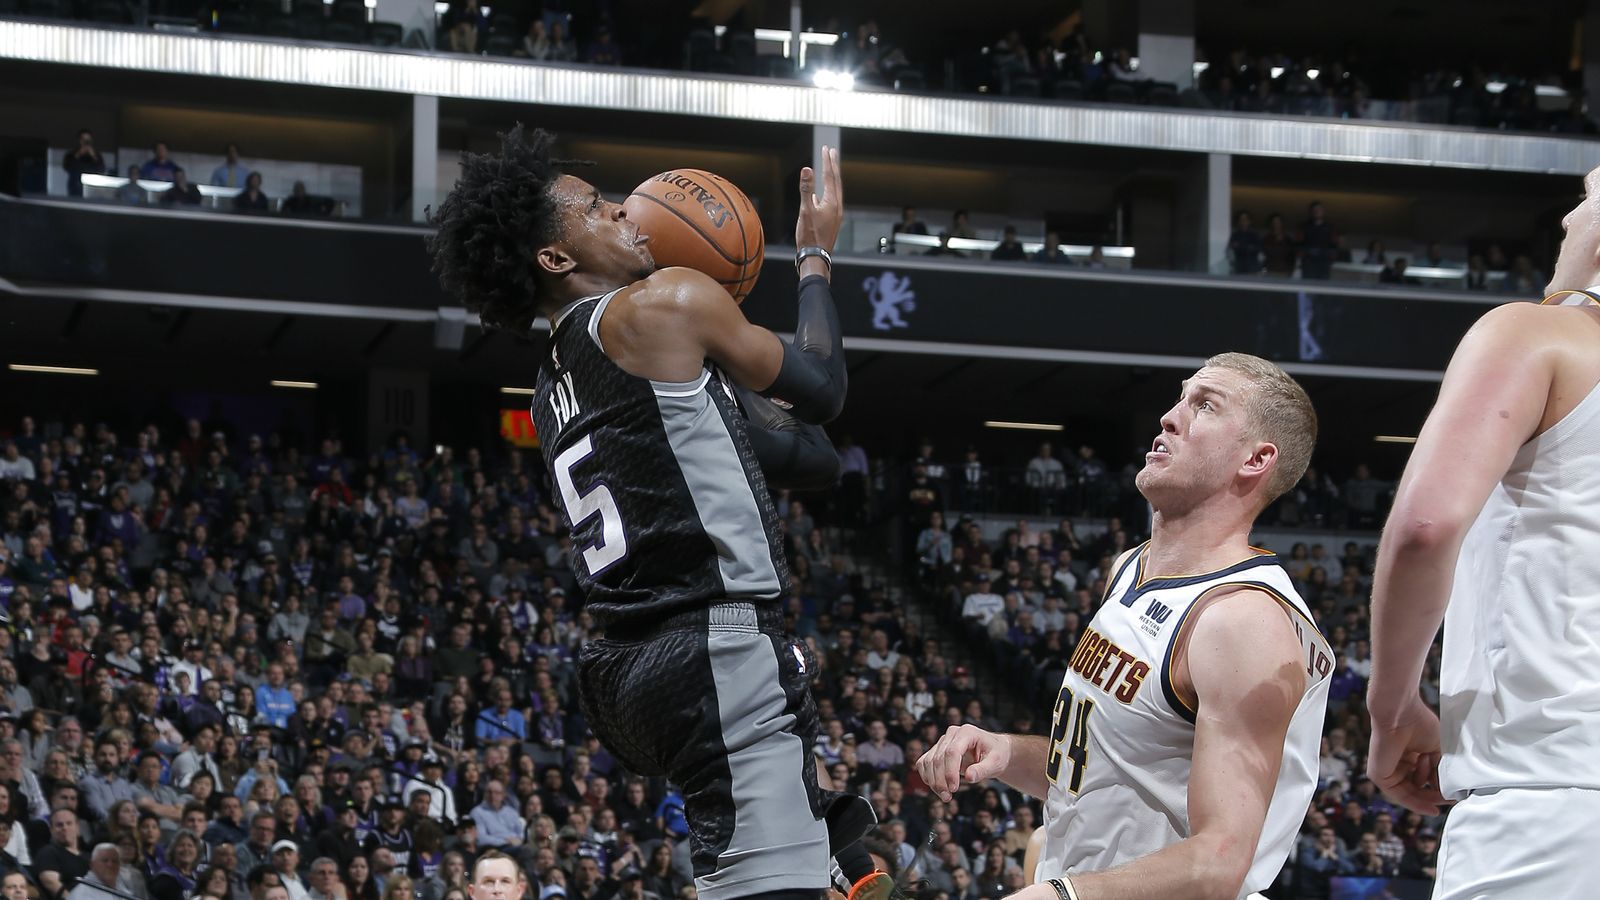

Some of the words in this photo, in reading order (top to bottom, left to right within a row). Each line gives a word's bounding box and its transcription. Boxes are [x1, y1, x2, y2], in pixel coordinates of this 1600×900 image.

[655, 171, 734, 229] SPALDIN
[549, 371, 581, 433] FOX
[553, 433, 628, 577] 5
[1140, 624, 1158, 637] UNION
[1145, 598, 1173, 624] WU
[1069, 628, 1150, 704] UGGETS
[1047, 686, 1095, 796] 24
